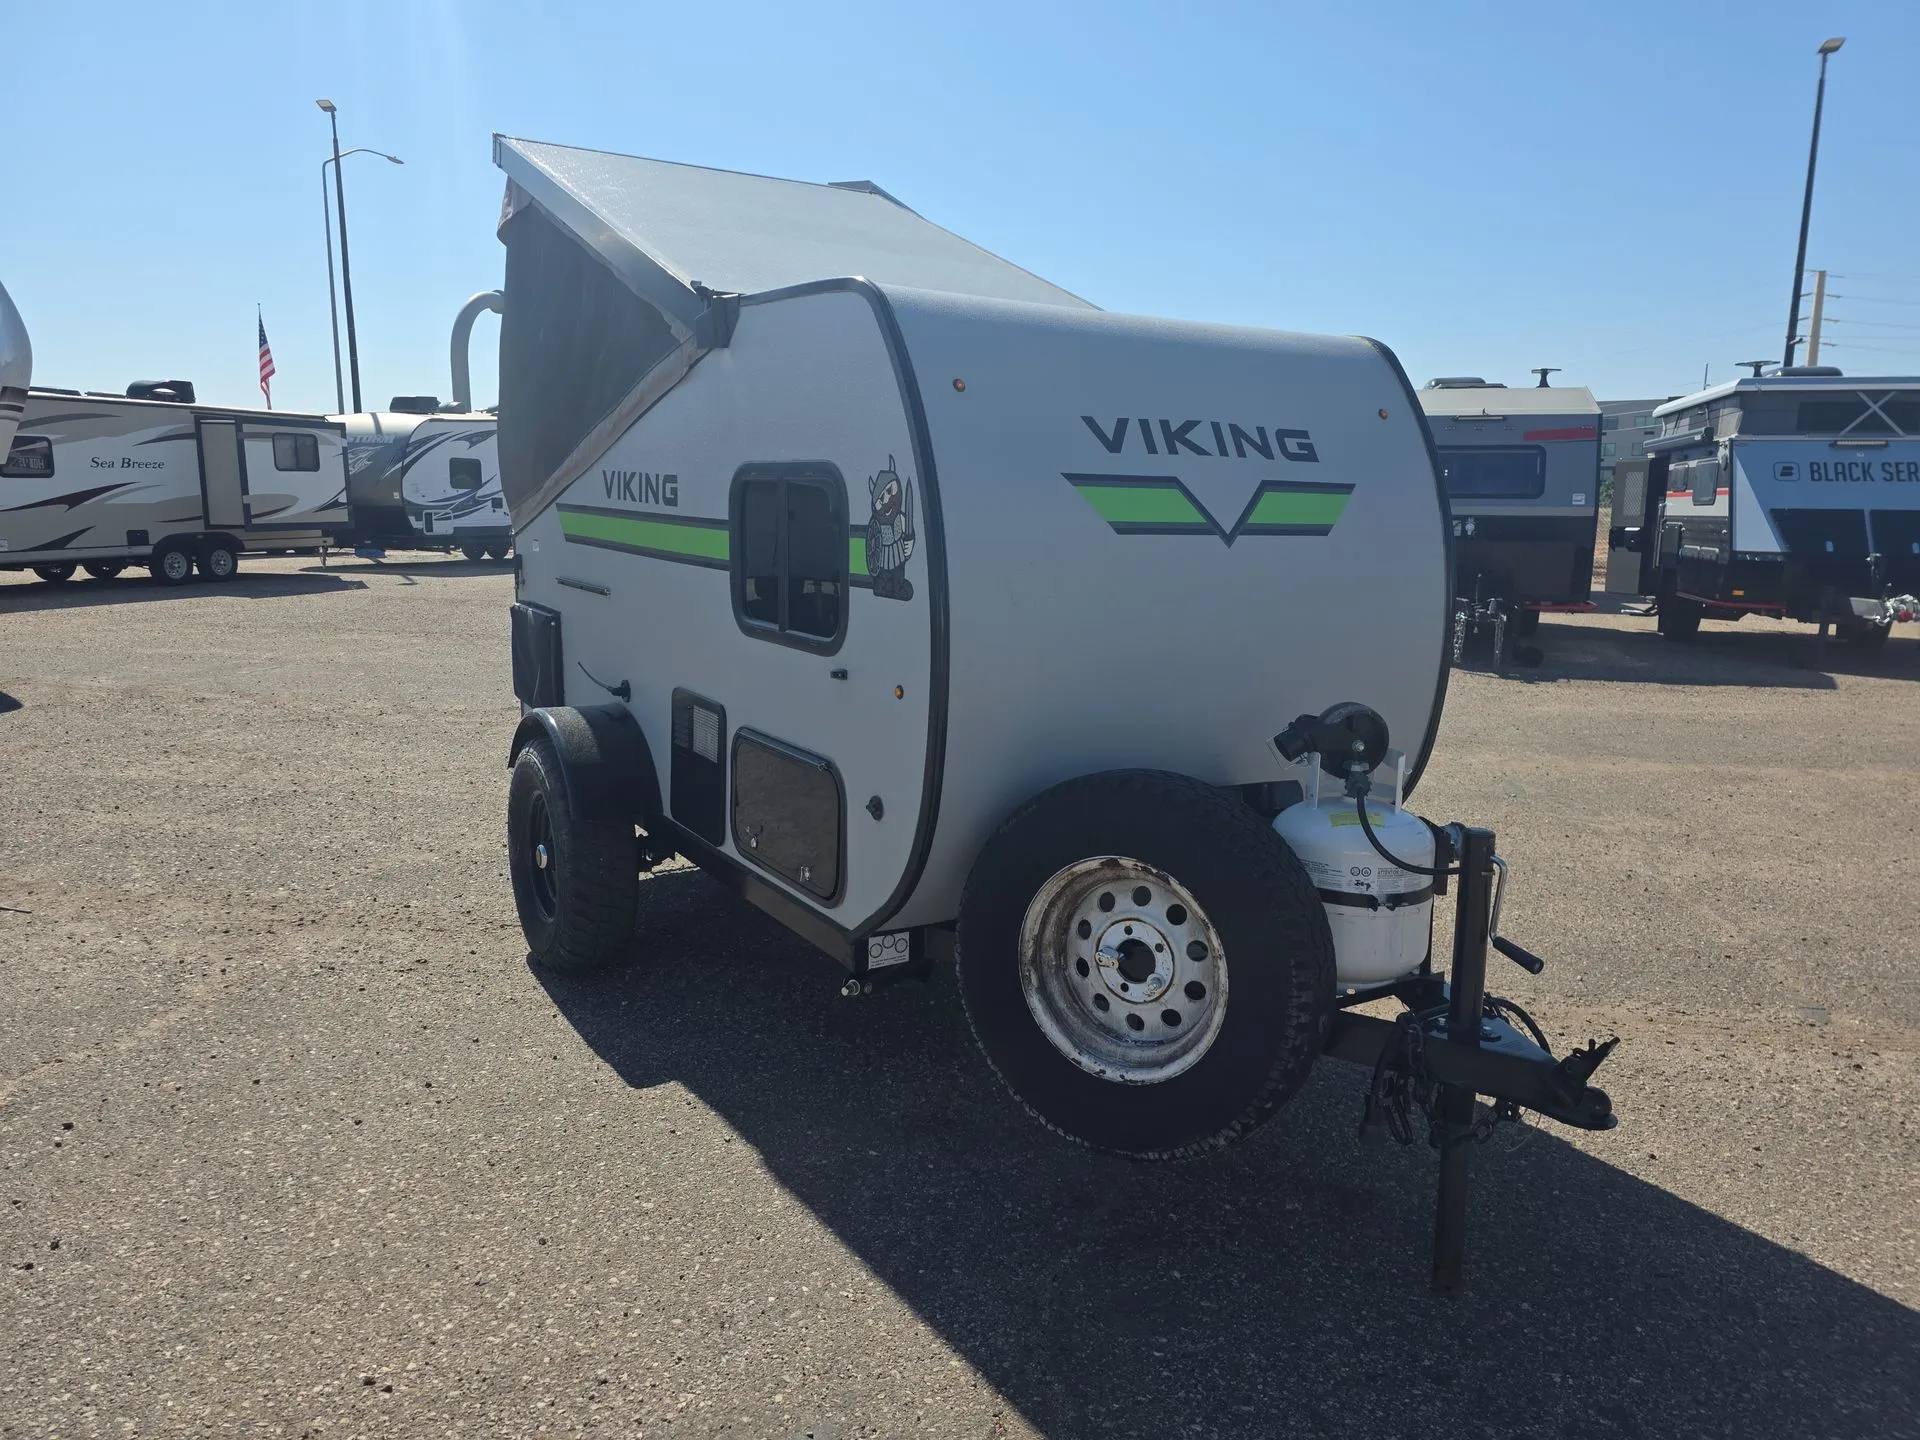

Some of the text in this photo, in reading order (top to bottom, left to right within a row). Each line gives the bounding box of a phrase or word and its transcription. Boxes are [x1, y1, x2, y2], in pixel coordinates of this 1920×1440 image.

[1080, 416, 1319, 462] VIKING
[90, 456, 165, 469] Sea Breeze
[1809, 461, 1920, 482] BLACK SER
[602, 470, 678, 507] VIKING
